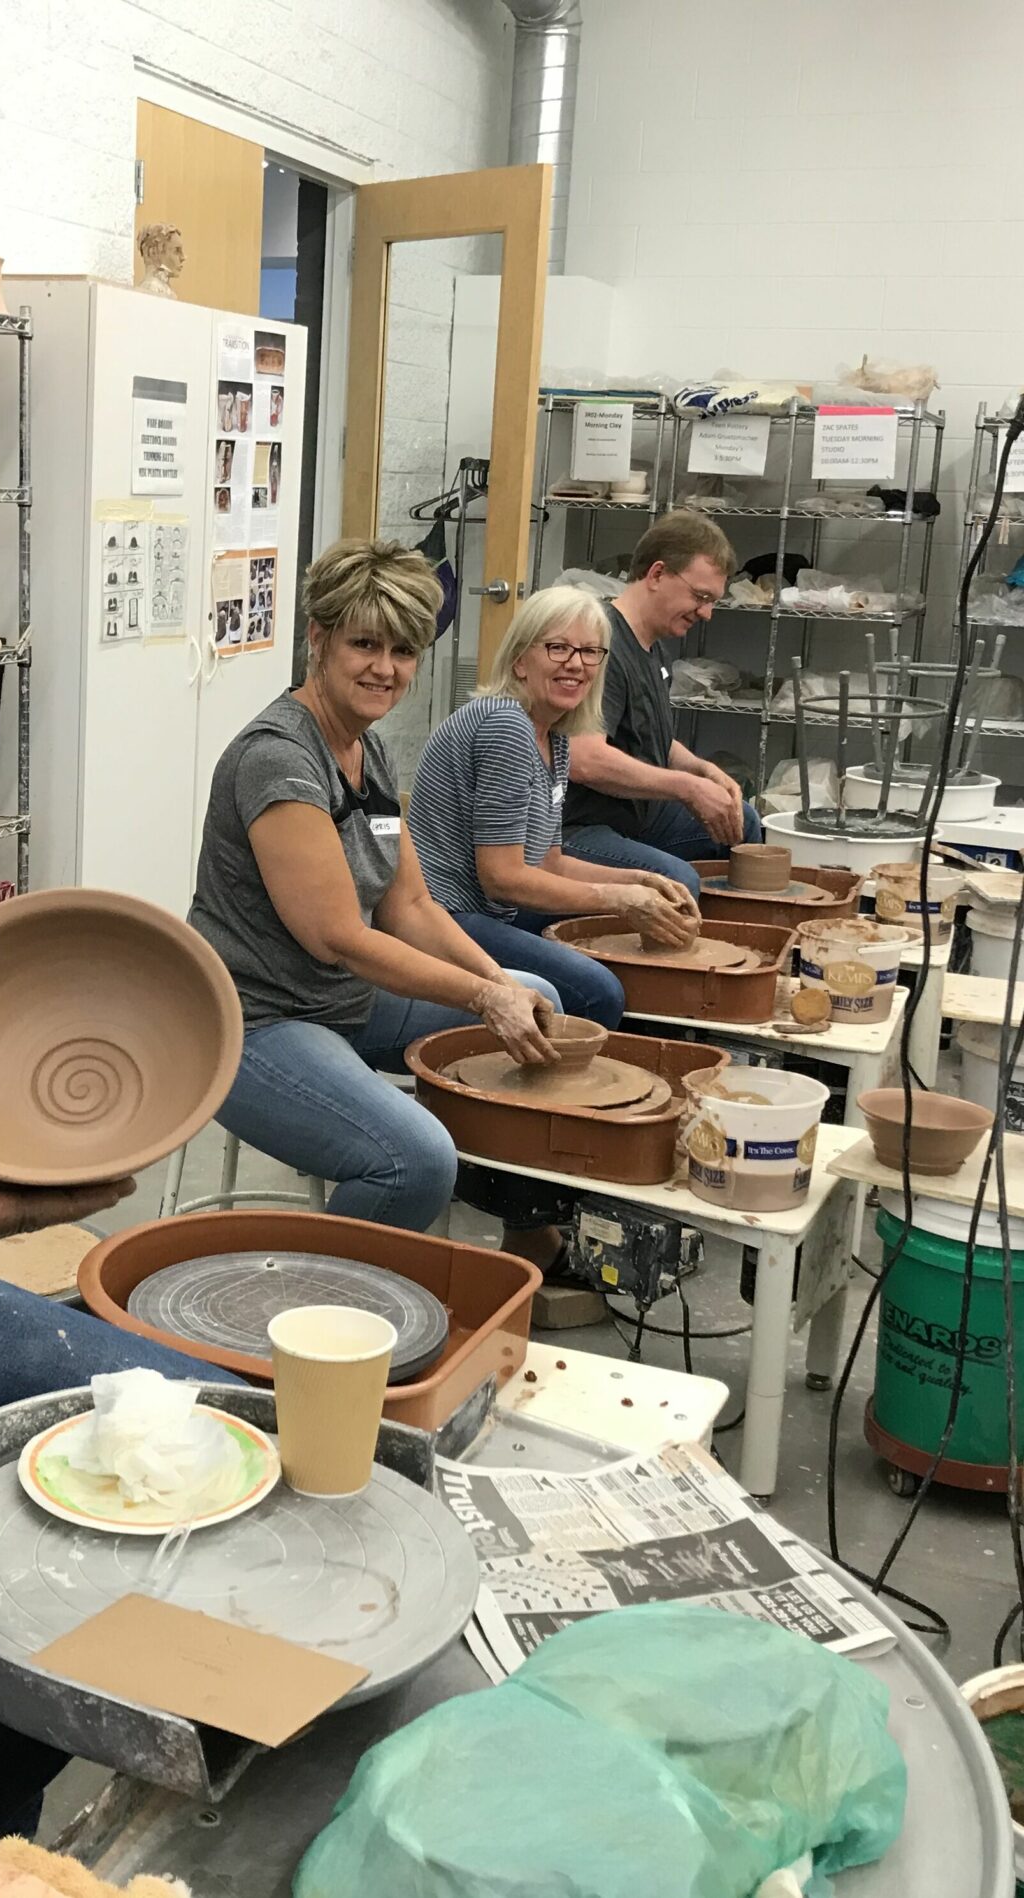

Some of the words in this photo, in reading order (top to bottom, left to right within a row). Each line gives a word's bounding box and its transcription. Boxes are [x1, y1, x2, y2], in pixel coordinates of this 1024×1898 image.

[584, 421, 608, 430] Morning
[827, 968, 873, 985] KEMPS
[851, 996, 874, 1013] SIZE
[747, 1146, 759, 1155] It's
[759, 1146, 774, 1156] The
[880, 1300, 1003, 1360] ENARDS
[939, 1363, 952, 1375] to
[782, 1602, 804, 1618] FOR
[785, 1590, 806, 1604] LET
[800, 1603, 816, 1616] US
[811, 1614, 835, 1634] SELL
